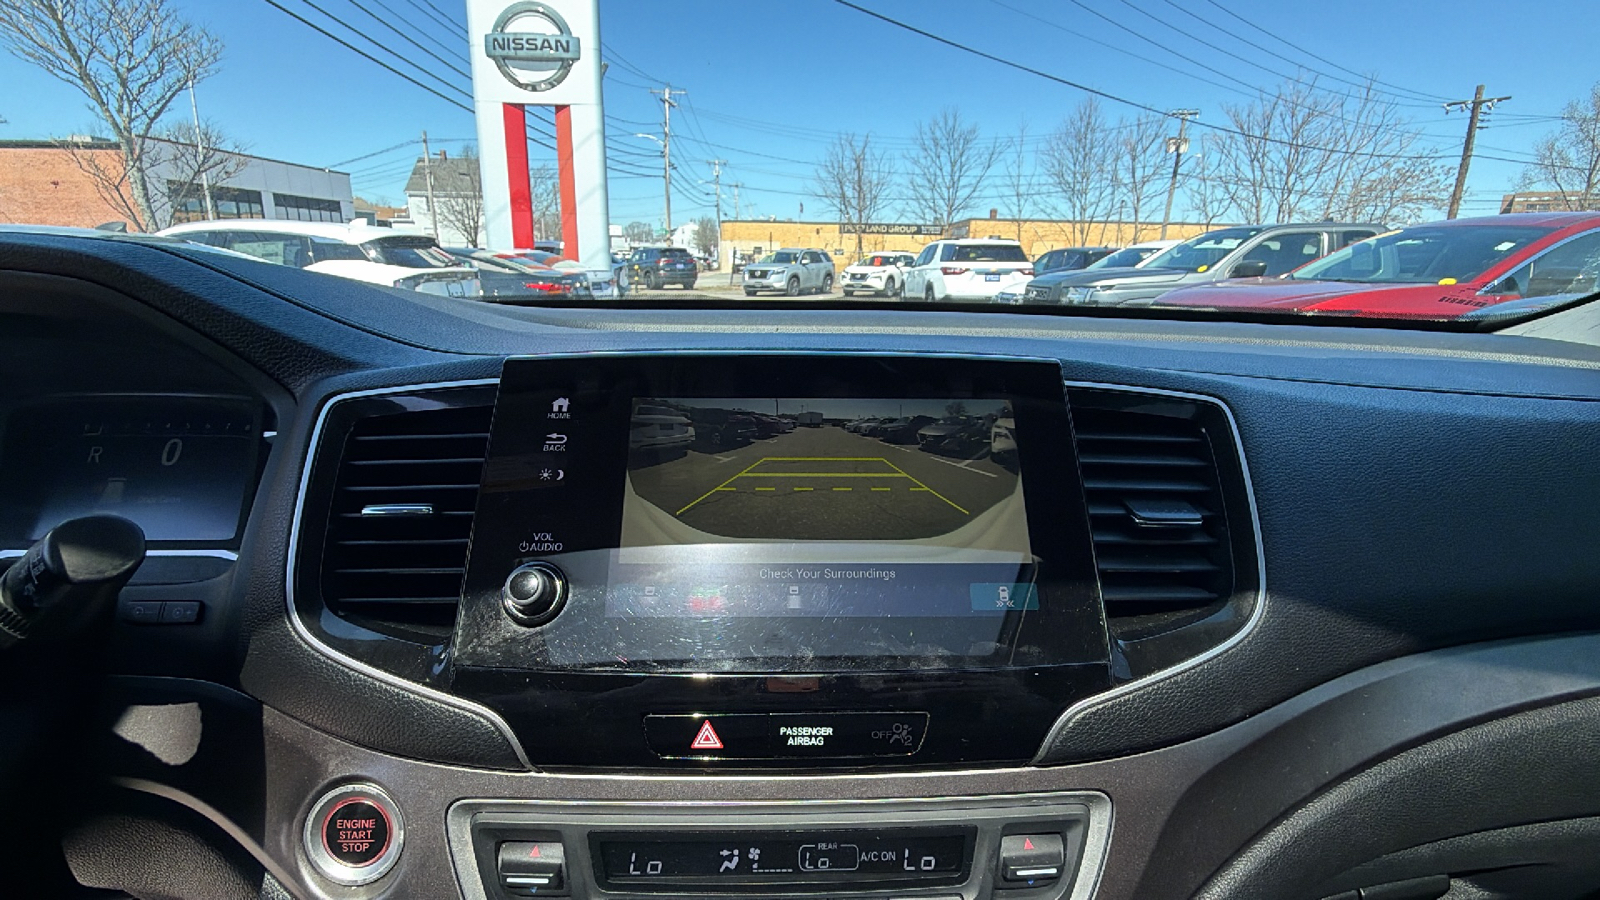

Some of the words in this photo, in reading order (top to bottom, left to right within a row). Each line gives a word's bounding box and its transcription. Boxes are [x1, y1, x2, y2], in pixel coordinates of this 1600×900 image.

[492, 37, 571, 53] NISSAN
[888, 225, 917, 234] GROUP
[87, 446, 103, 464] R
[161, 438, 183, 466] 0
[533, 532, 554, 541] VOL
[530, 542, 563, 551] AUDIO
[759, 568, 794, 579] Check
[796, 568, 821, 579] Your
[824, 568, 896, 581] Surroundings
[779, 727, 834, 736] PASSENGER
[871, 730, 893, 739] OFF
[787, 736, 825, 746] AIRBAG
[336, 819, 376, 829] ENGINE
[339, 830, 373, 840] START
[341, 842, 370, 853] STOP
[817, 842, 839, 851] REAR
[804, 851, 830, 869] Lo
[860, 851, 879, 862] A/C
[880, 851, 897, 861] ON
[903, 847, 936, 871] Lo
[629, 851, 663, 875] Lo
